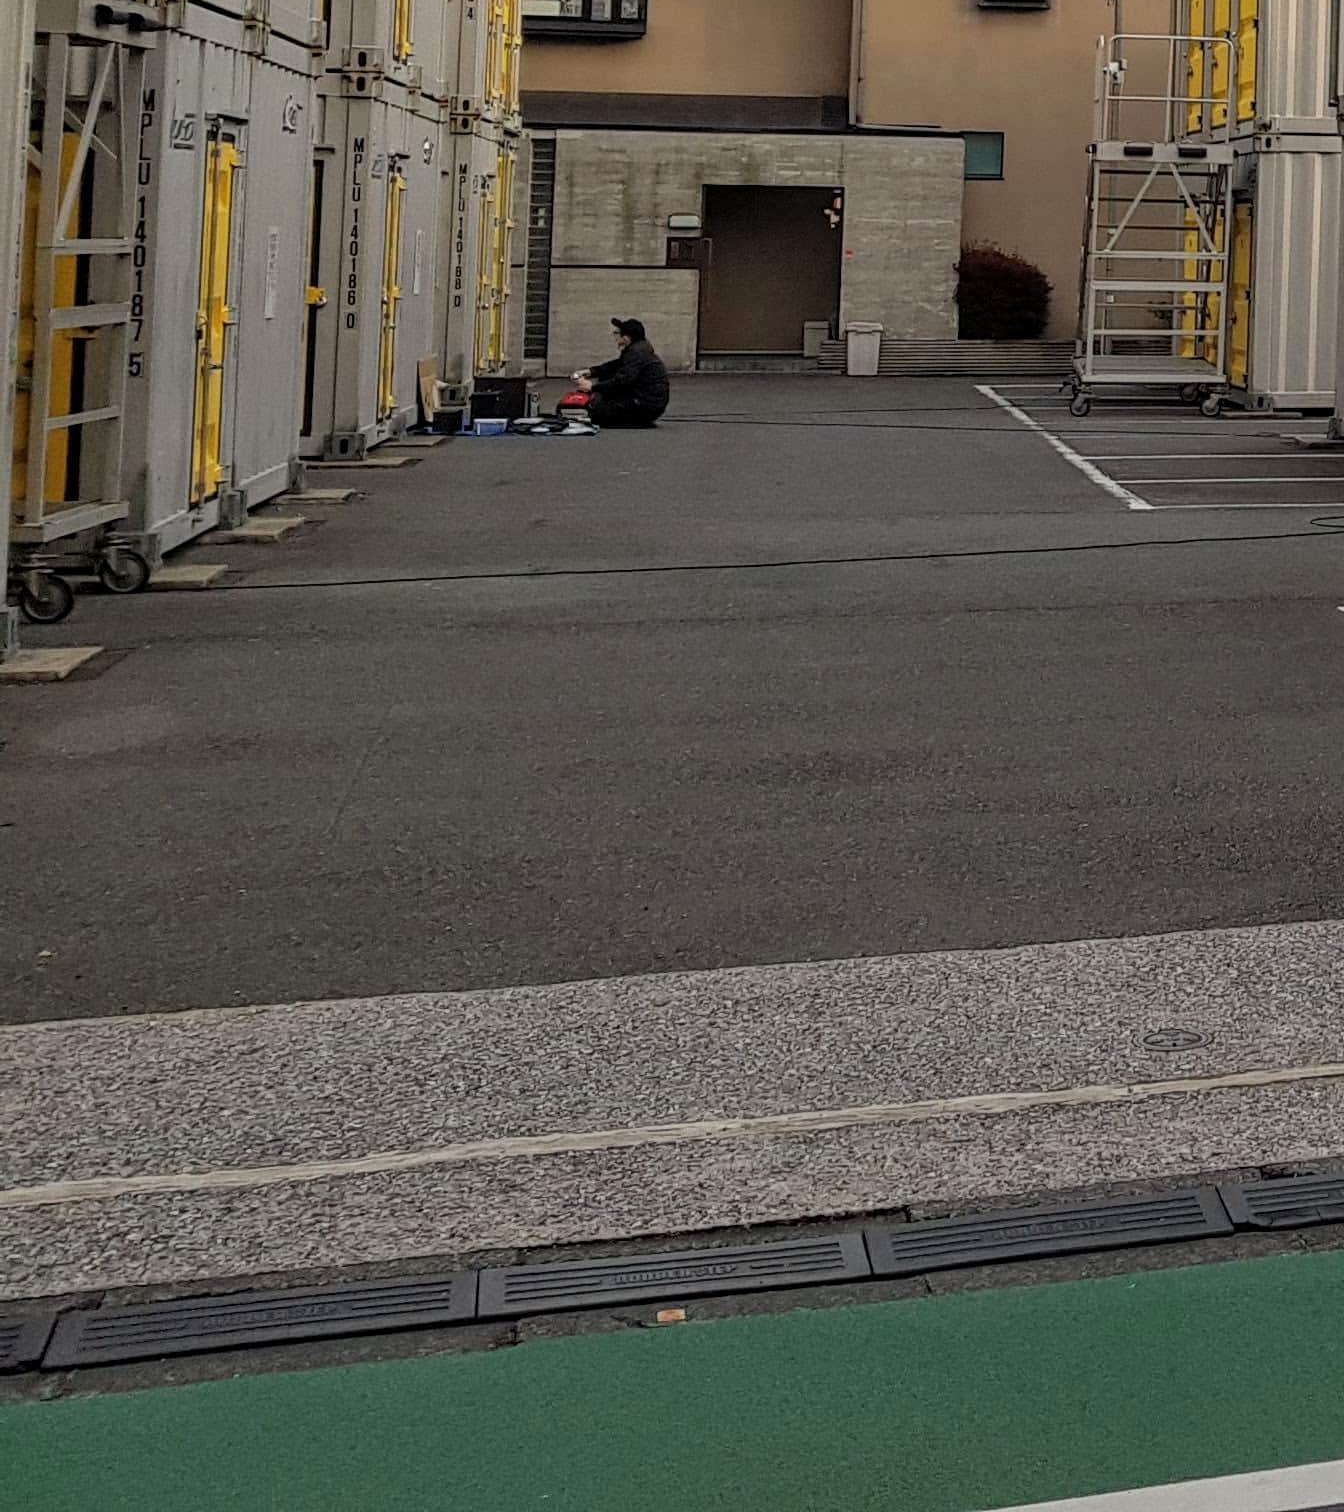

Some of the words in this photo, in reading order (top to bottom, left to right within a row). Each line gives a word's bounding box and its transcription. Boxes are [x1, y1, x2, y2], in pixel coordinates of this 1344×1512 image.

[138, 89, 155, 186] MPLU
[352, 138, 365, 202] MPLU
[130, 196, 147, 342] 140187
[347, 208, 359, 305] 140186
[129, 353, 142, 377] 5
